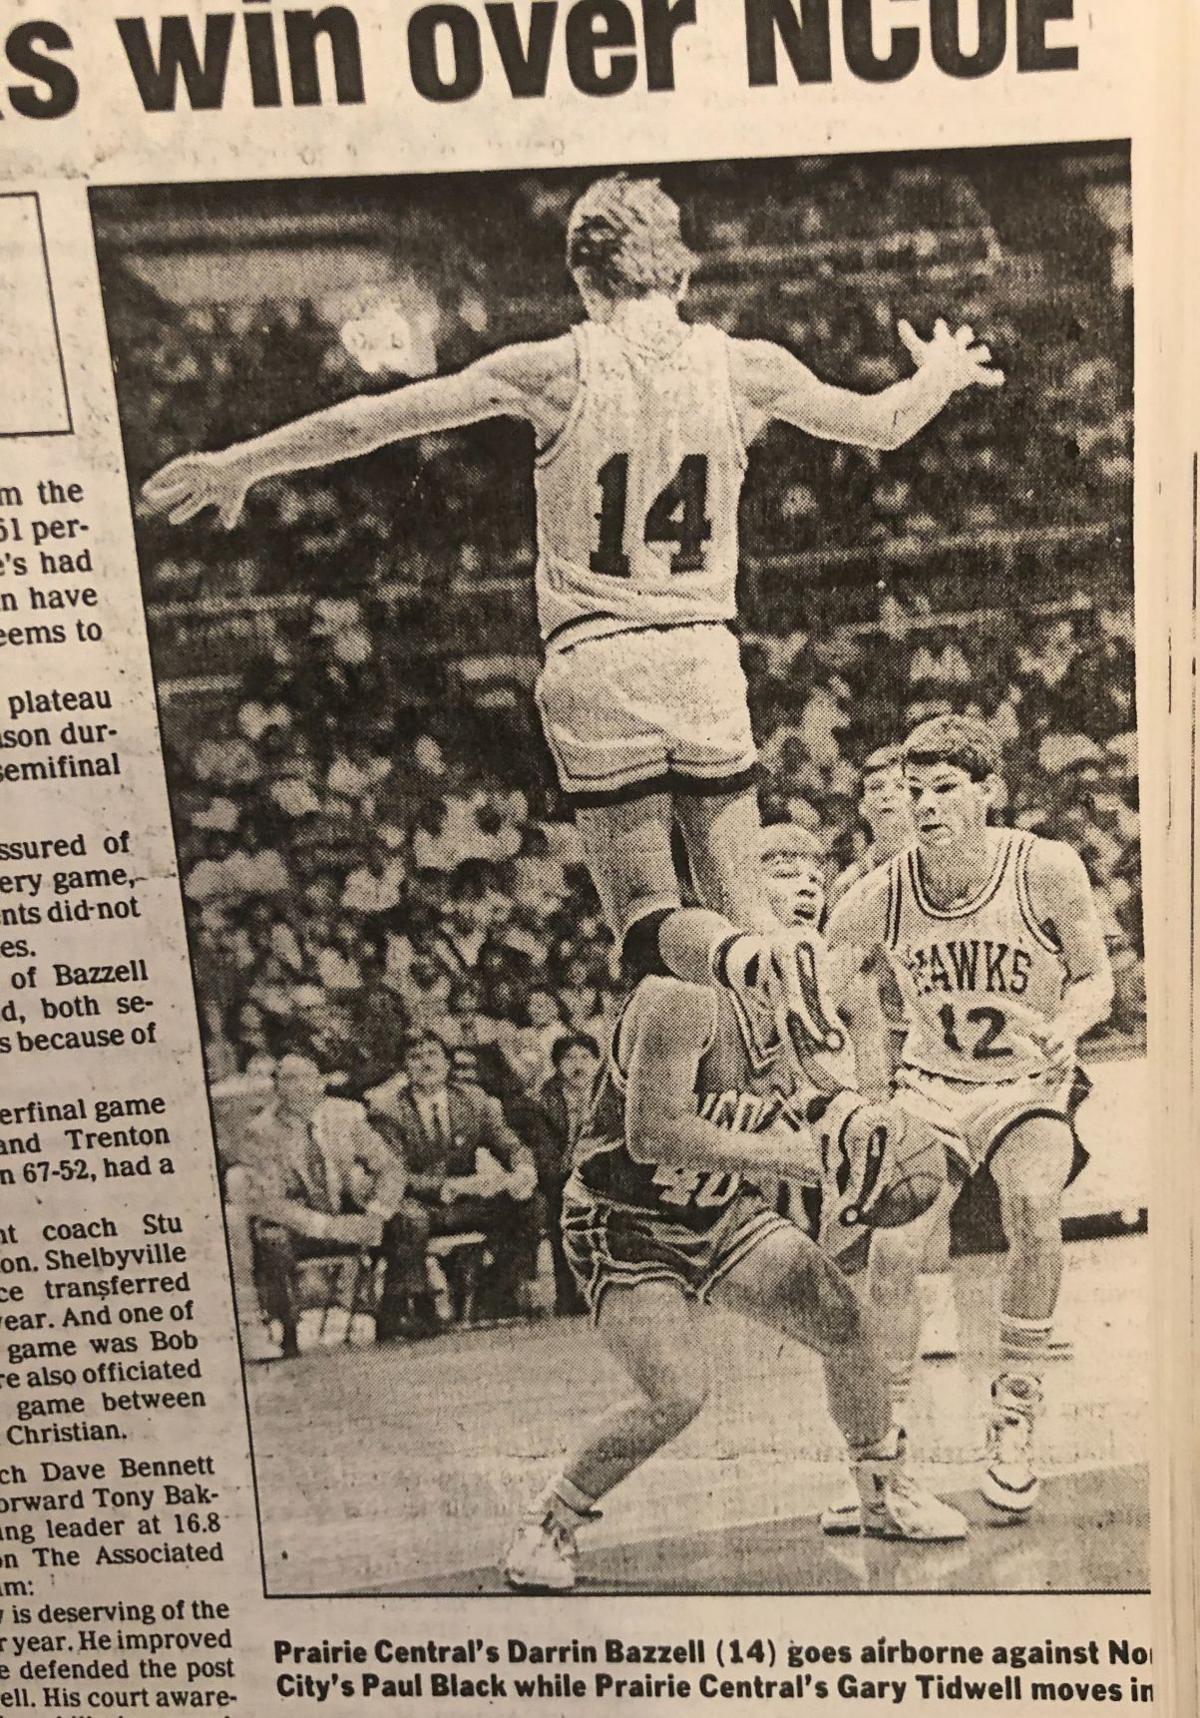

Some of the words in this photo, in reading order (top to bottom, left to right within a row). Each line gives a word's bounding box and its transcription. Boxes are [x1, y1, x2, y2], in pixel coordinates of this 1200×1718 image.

[114, 0, 366, 113] win
[405, 0, 697, 104] over
[37, 480, 84, 505] the
[589, 452, 713, 579] 14
[31, 519, 89, 545] per-
[40, 549, 93, 574] had
[29, 587, 98, 609] have
[76, 620, 102, 642] to
[8, 690, 112, 719] plateau
[0, 728, 51, 748] son
[60, 722, 117, 744] dur-
[103, 830, 129, 854] of
[53, 868, 135, 895] game,
[11, 966, 36, 989] of
[53, 959, 148, 986] Bazzell
[41, 996, 100, 1019] both
[116, 996, 153, 1014] se-
[17, 1029, 124, 1052] because
[131, 1022, 156, 1044] of
[937, 1002, 1013, 1060] 12
[95, 1097, 165, 1122] game
[64, 1127, 170, 1150] Trenton
[23, 1159, 96, 1183] 67-52,
[103, 1156, 151, 1178] had
[159, 1158, 175, 1174] a
[42, 1217, 118, 1241] coach
[143, 1214, 183, 1235] Stu
[45, 1243, 186, 1270] Shelbyville
[45, 1271, 191, 1298] transferred
[0, 1313, 54, 1331] ear.
[62, 1306, 112, 1327] And
[119, 1306, 163, 1324] one
[170, 1300, 193, 1321] of
[7, 1341, 76, 1364] game
[89, 1337, 138, 1353] was
[150, 1330, 198, 1351] Bob
[27, 1367, 76, 1387] also
[83, 1359, 202, 1383] officiated
[17, 1398, 84, 1421] game
[102, 1391, 206, 1411] between
[6, 1422, 127, 1445] Christian.
[41, 1462, 105, 1482] Dave
[119, 1456, 215, 1478] Bennett
[92, 1488, 154, 1511] Tony
[164, 1484, 219, 1505] Bak-
[46, 1518, 125, 1538] leader
[138, 1516, 161, 1535] at
[175, 1512, 221, 1533] 16.8
[32, 1548, 80, 1567] The
[96, 1542, 224, 1565] Associated
[12, 1604, 32, 1624] is
[38, 1601, 155, 1624] deserving
[162, 1600, 184, 1620] of
[192, 1600, 229, 1619] the
[13, 1636, 73, 1656] year.
[79, 1631, 111, 1650] He
[118, 1629, 232, 1653] improved
[274, 1640, 367, 1663] Prairie
[375, 1639, 499, 1663] Central's
[508, 1639, 596, 1663] Darrin
[605, 1639, 705, 1663] Bazzell
[717, 1639, 775, 1667] (14)
[788, 1646, 852, 1667] goes
[861, 1637, 983, 1664] airborne
[992, 1640, 1099, 1668] against
[1107, 1638, 1153, 1666] No
[20, 1660, 129, 1679] defended
[140, 1659, 176, 1678] the
[187, 1658, 235, 1682] post
[43, 1688, 81, 1707] His
[88, 1689, 149, 1707] court
[156, 1691, 237, 1707] aware-
[277, 1674, 355, 1702] City's
[362, 1674, 422, 1697] Paul
[431, 1674, 507, 1697] Black
[514, 1674, 586, 1697] while
[596, 1674, 691, 1698] Prairie
[699, 1674, 828, 1699] Central's
[838, 1675, 906, 1704] Gary
[915, 1675, 1021, 1700] Tidwell
[1031, 1683, 1122, 1701] moves
